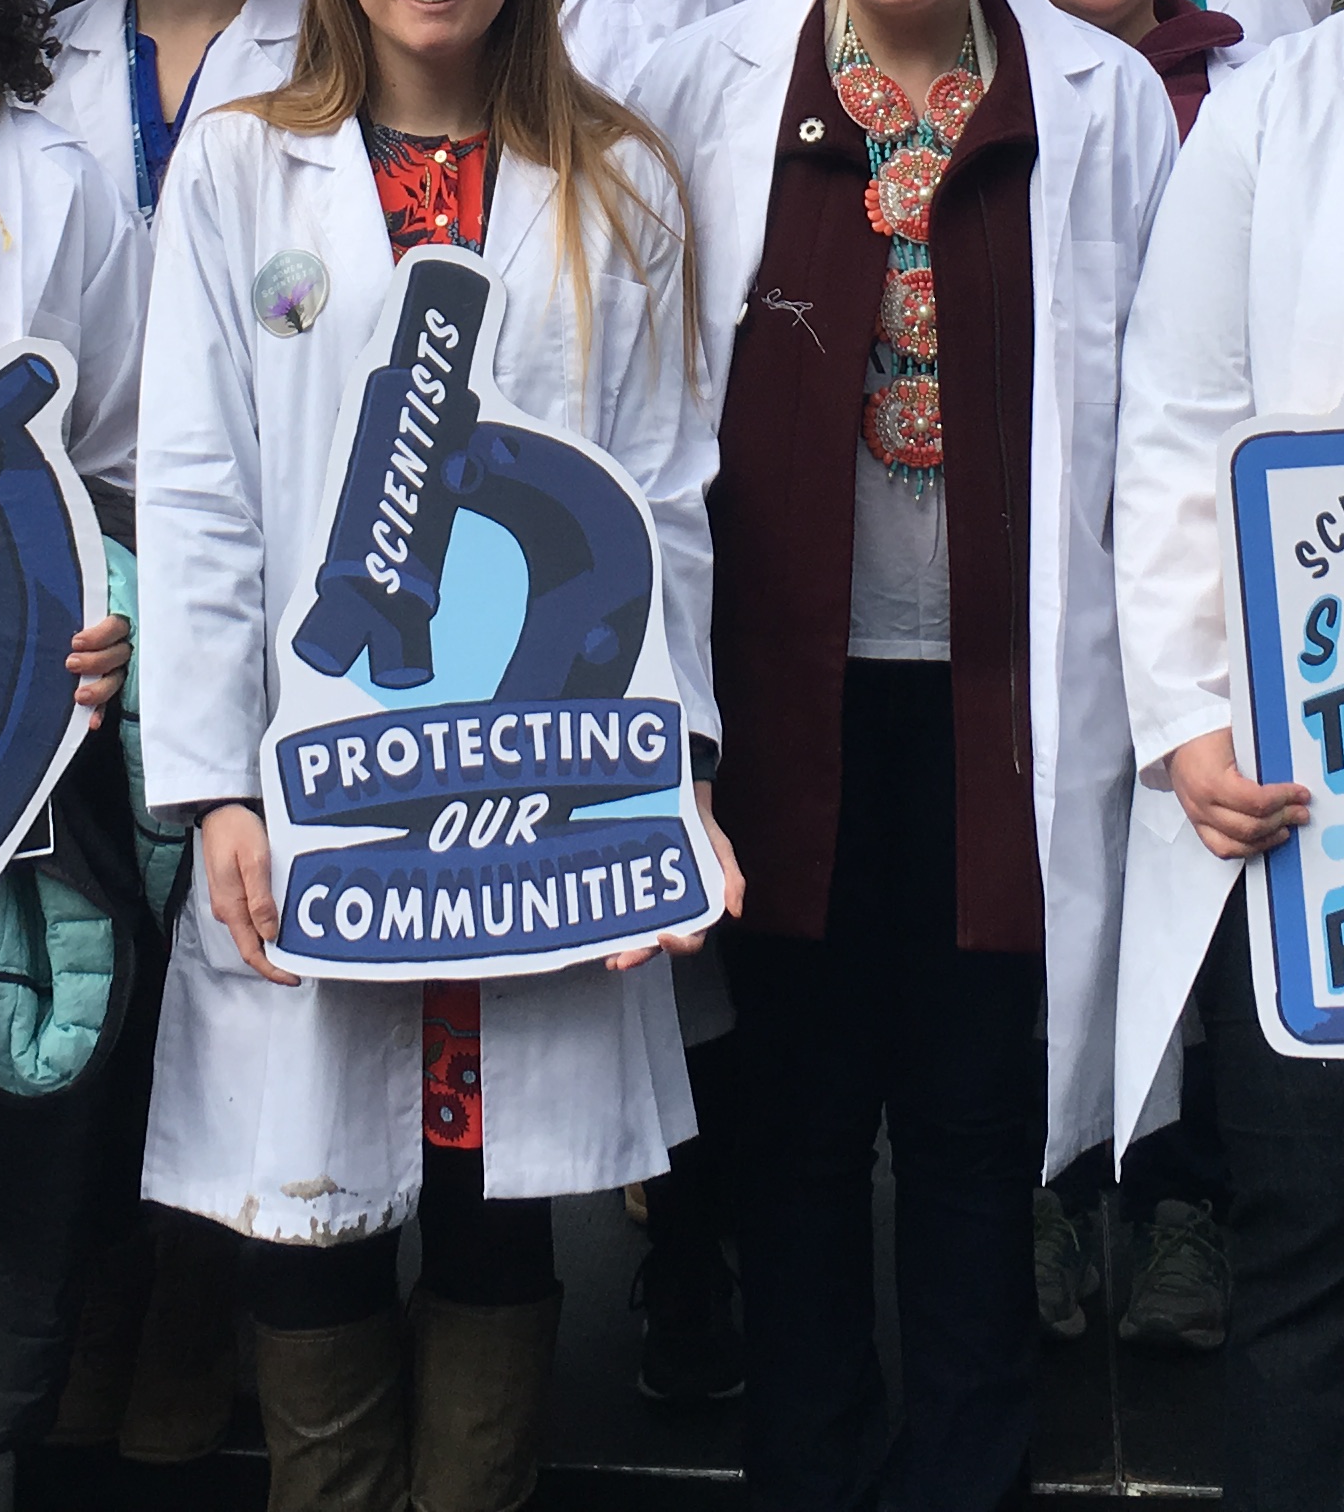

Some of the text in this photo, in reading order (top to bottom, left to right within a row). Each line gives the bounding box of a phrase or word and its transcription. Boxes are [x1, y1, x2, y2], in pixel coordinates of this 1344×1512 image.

[365, 307, 460, 595] SCIENTISTS
[297, 712, 668, 797] PROTECTING
[427, 793, 550, 854] OUR
[297, 848, 687, 940] COMMUNITIES
